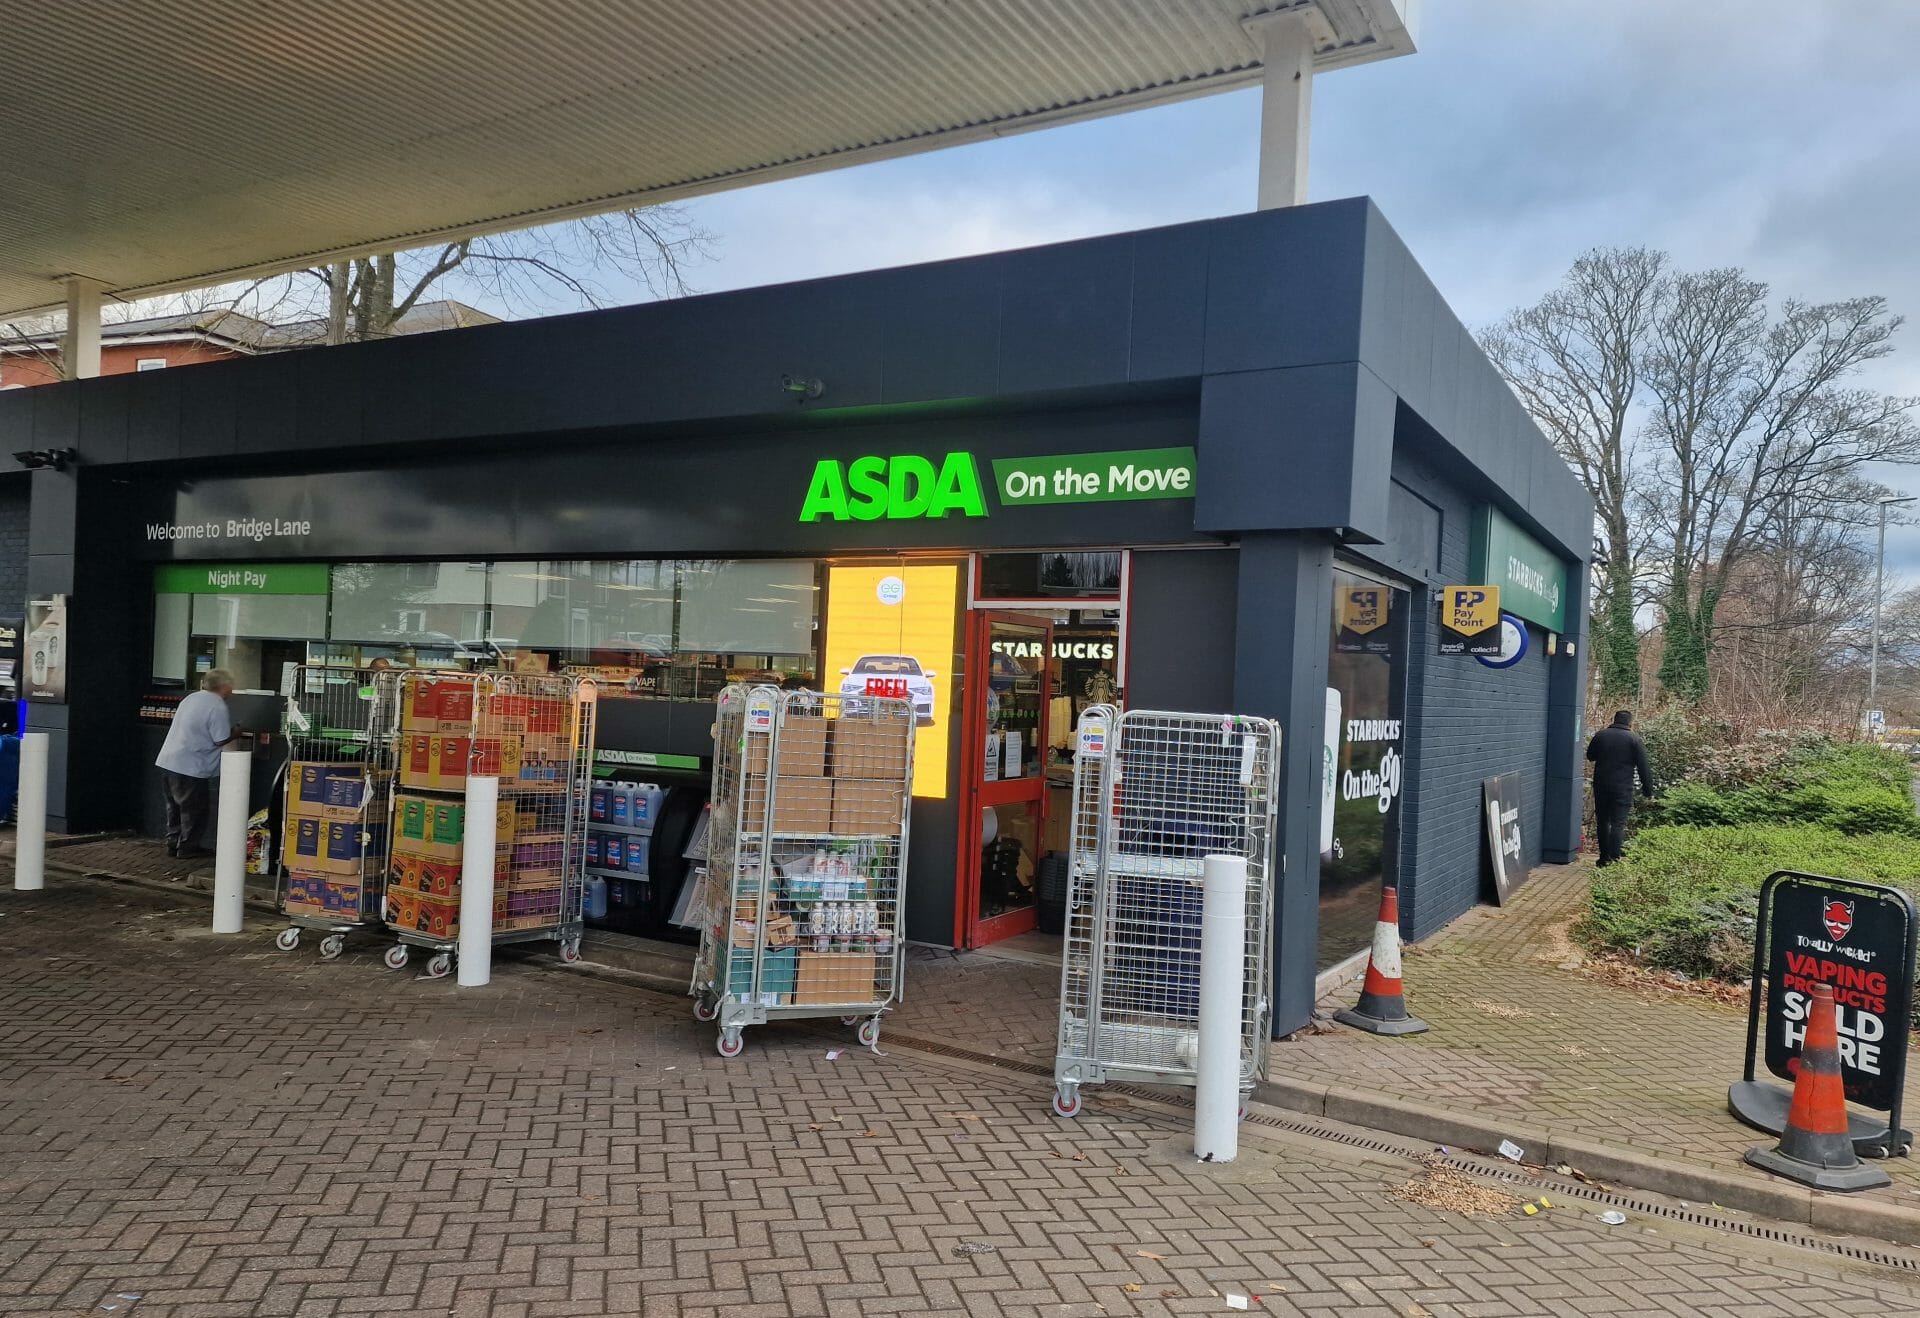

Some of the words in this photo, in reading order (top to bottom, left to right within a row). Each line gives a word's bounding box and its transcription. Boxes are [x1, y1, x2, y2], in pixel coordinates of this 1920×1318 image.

[799, 452, 988, 523] ASDA
[1005, 471, 1047, 499] On
[1053, 467, 1100, 496] the
[1107, 464, 1192, 493] Move
[146, 522, 204, 541] Welcome
[206, 522, 220, 537] to
[227, 518, 272, 541] Bridge
[274, 518, 311, 536] Lane
[208, 570, 241, 588] Night
[244, 570, 267, 588] Pay
[1508, 555, 1544, 597] STARBUCKS
[1454, 608, 1474, 619] Pay
[1454, 618, 1484, 627] Point
[865, 677, 908, 699] FREE!
[1347, 719, 1400, 742] STARBUCKS
[597, 749, 627, 763] ASDA
[1343, 769, 1361, 801] On
[1361, 769, 1380, 797] the
[1378, 746, 1401, 814] go
[1786, 950, 1887, 996] VAPING
[1783, 973, 1887, 1014] PROUCTS
[1782, 991, 1885, 1043] SLD
[1784, 1020, 1881, 1077] HRE
